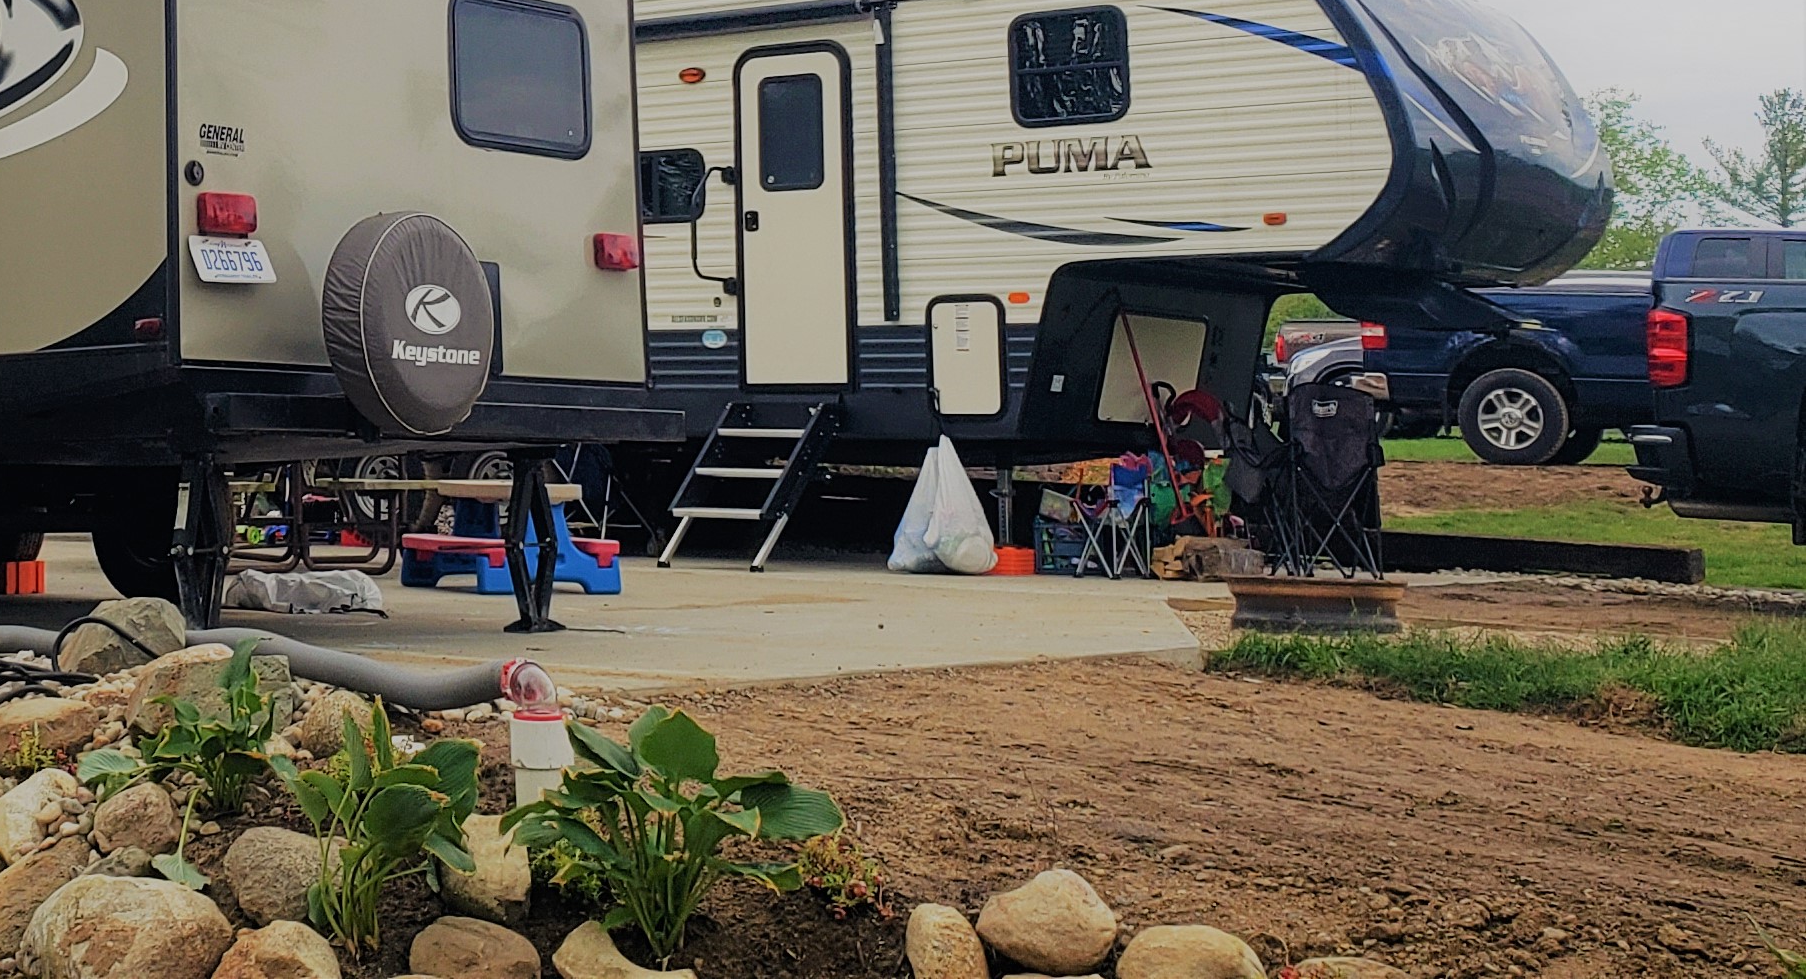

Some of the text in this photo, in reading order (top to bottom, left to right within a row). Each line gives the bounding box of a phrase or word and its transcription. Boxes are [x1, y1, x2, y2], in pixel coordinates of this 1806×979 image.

[199, 123, 244, 143] GENERAL
[991, 134, 1153, 177] PUMA
[201, 249, 263, 271] D266796
[1685, 289, 1764, 303] Z71
[391, 339, 481, 366] Keystone
